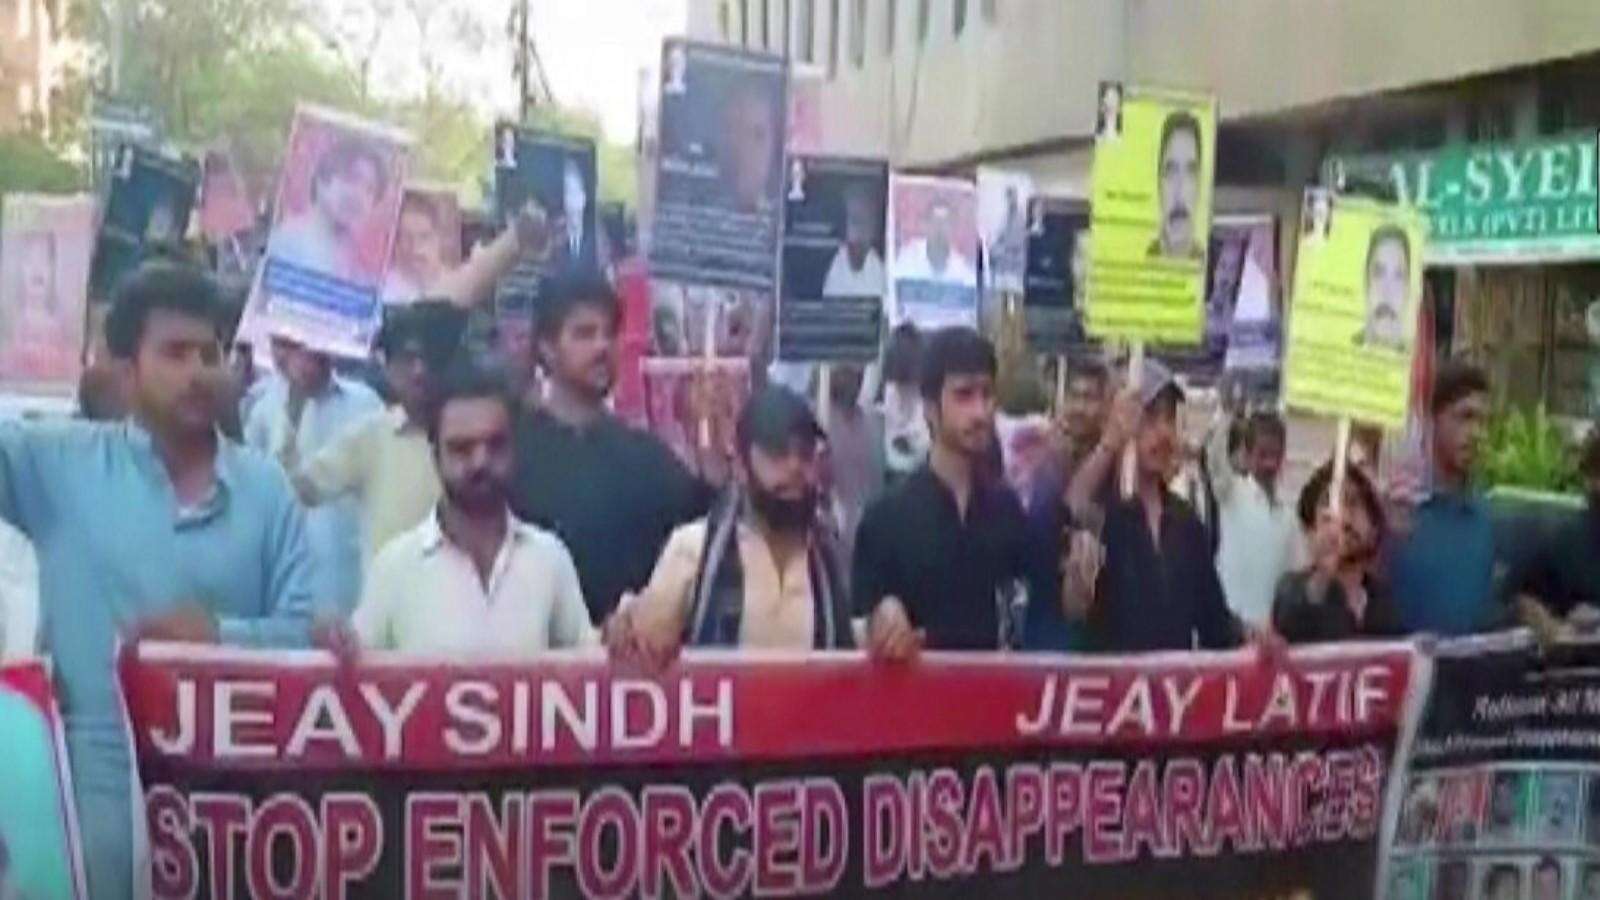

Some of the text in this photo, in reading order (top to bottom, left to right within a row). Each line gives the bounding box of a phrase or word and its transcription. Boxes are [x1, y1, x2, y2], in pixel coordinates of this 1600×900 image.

[149, 679, 733, 758] JEAY SINDH
[1015, 665, 1393, 736] JEAY LATIF
[144, 744, 1381, 900] STOP ENFORCED DISAPPEARANCES
